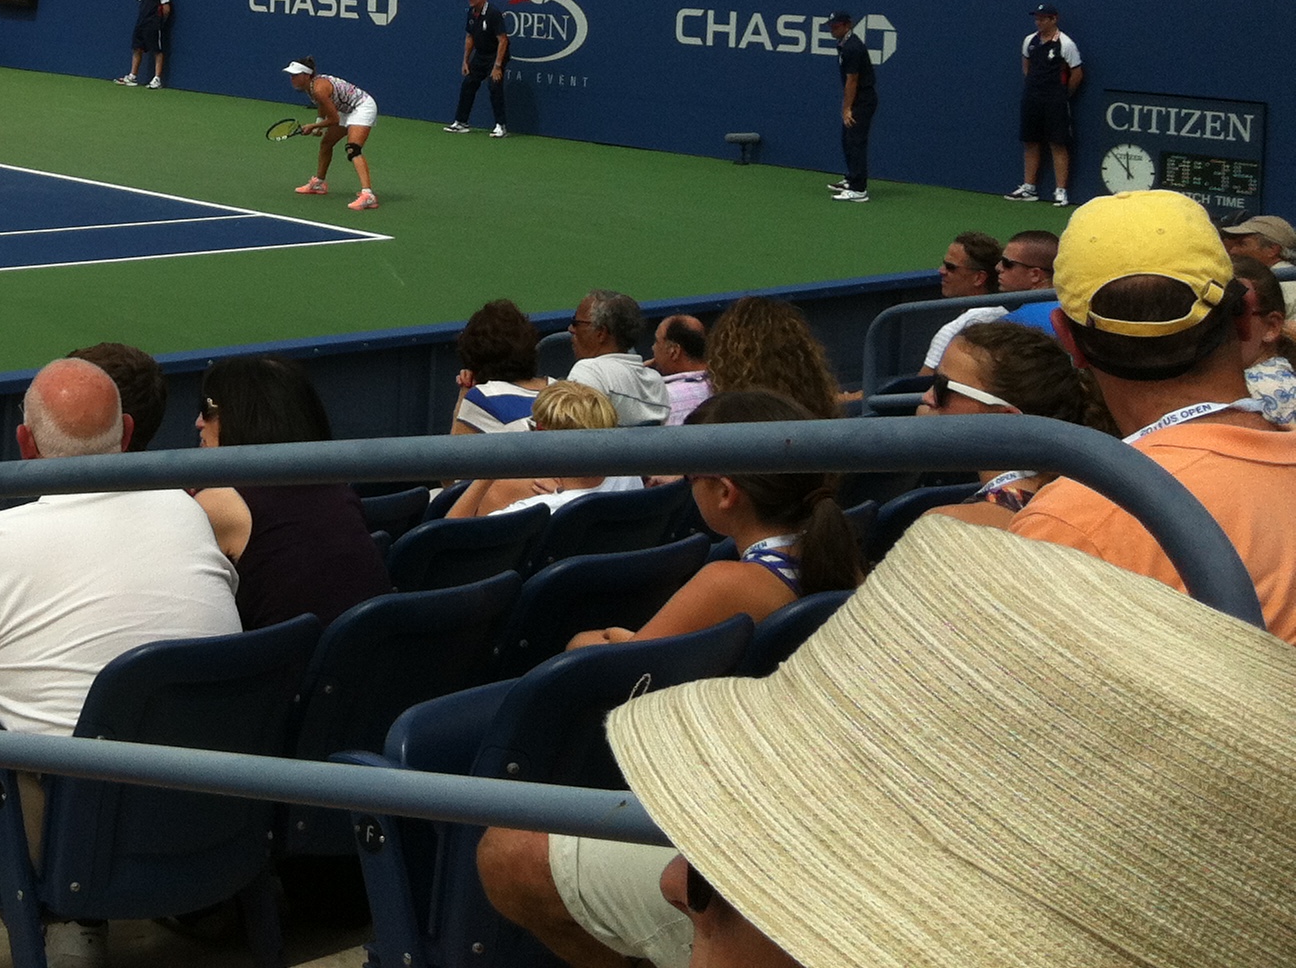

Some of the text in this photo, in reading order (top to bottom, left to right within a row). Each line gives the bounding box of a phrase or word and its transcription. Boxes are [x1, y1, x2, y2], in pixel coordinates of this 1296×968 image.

[503, 10, 570, 40] OPEN
[675, 8, 839, 56] CHASE
[536, 72, 589, 87] EVENT
[1106, 102, 1254, 143] CITIZEN
[1215, 195, 1245, 209] TIME
[1162, 414, 1179, 426] US
[1180, 403, 1212, 419] OPEN
